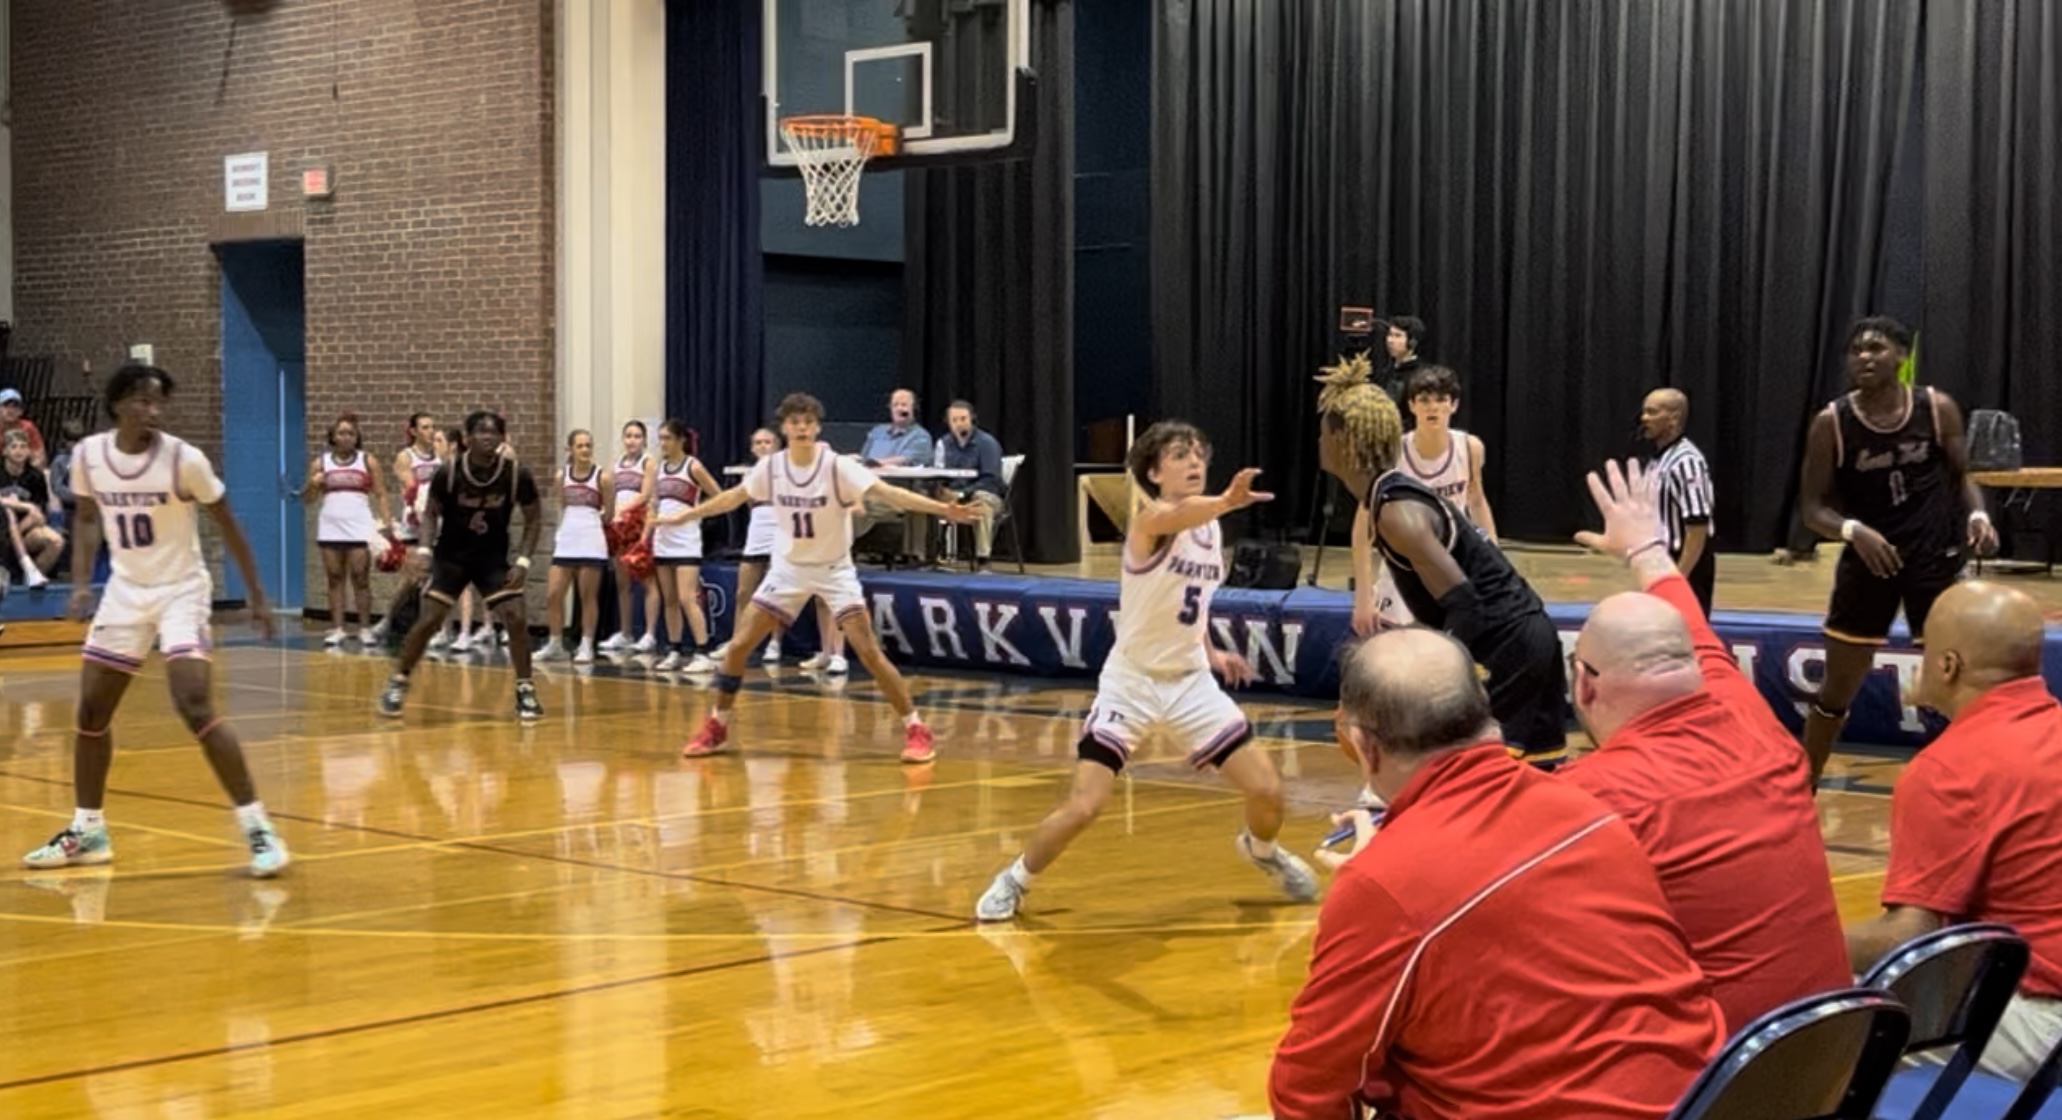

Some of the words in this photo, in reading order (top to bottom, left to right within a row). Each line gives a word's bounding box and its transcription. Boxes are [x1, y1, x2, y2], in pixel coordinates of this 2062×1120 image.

[777, 494, 829, 508] PARKVIEW
[115, 513, 155, 550] 10
[792, 511, 816, 539] 11
[1177, 585, 1202, 627] 5
[873, 593, 1304, 686] ARKVW
